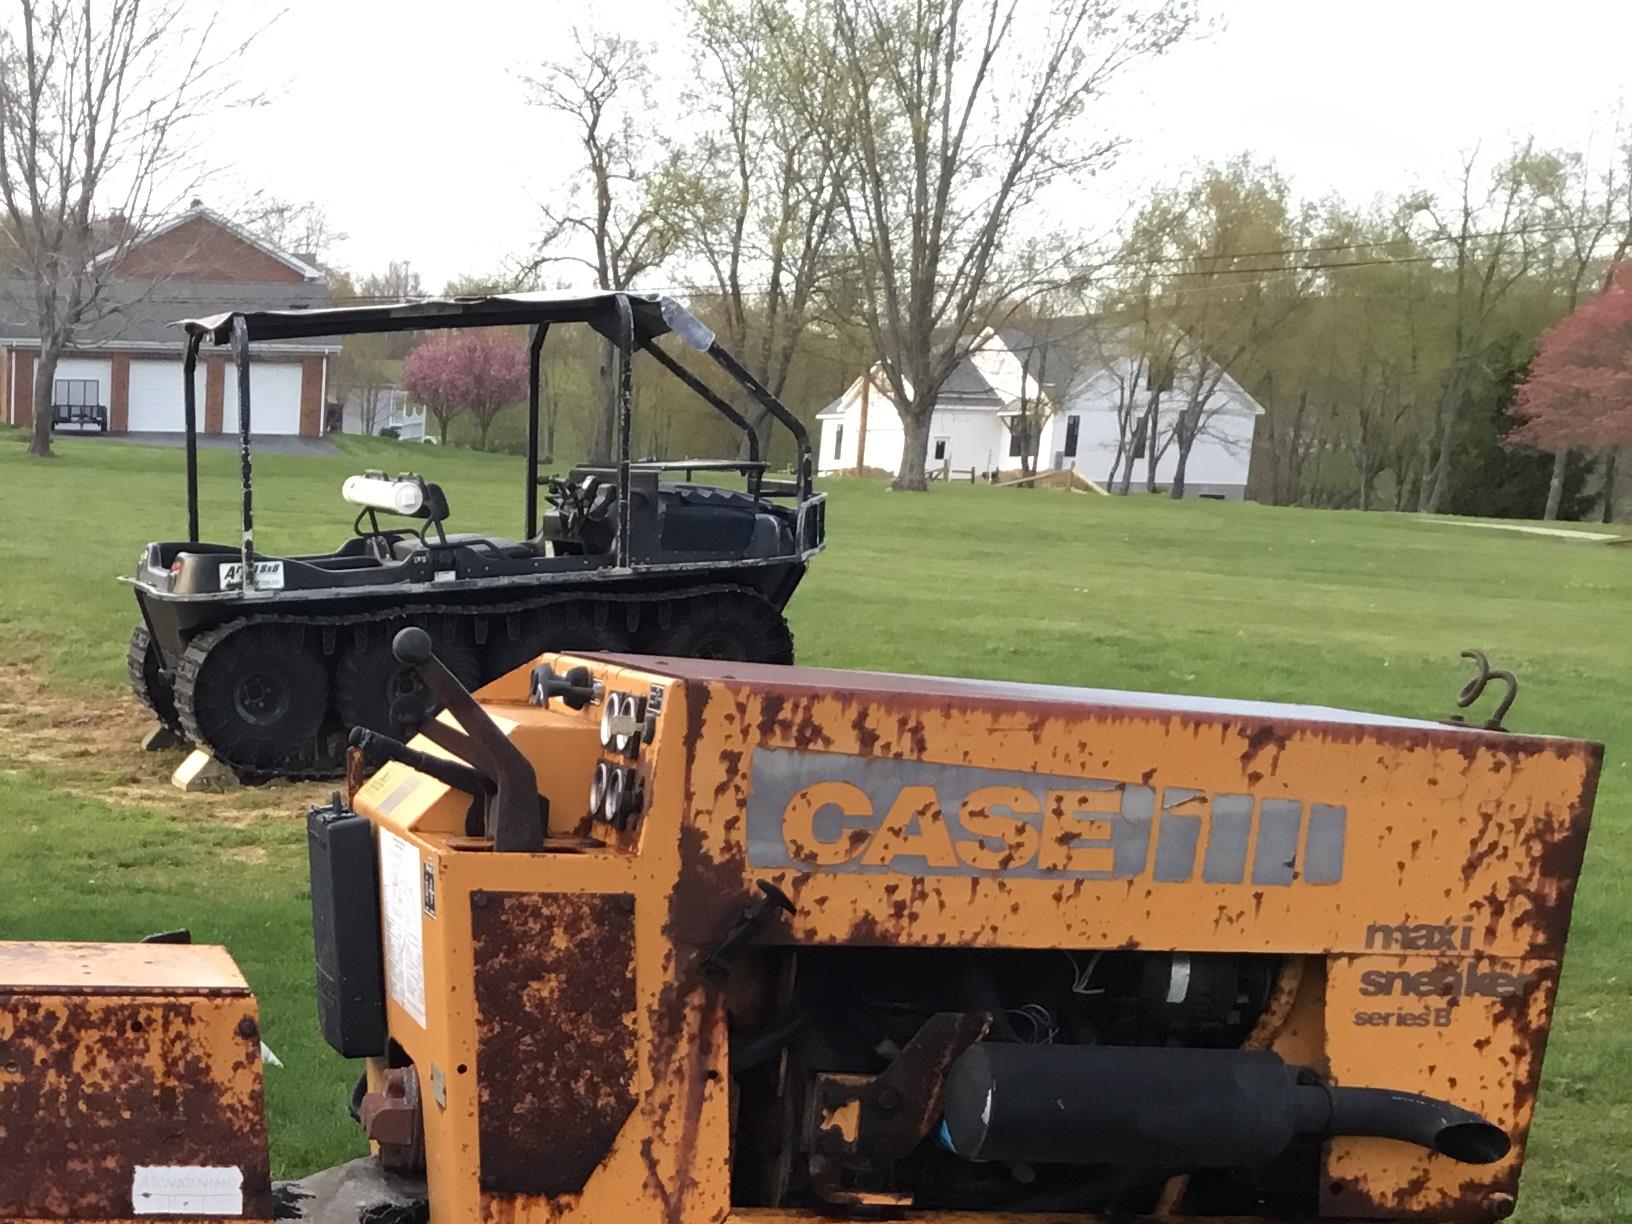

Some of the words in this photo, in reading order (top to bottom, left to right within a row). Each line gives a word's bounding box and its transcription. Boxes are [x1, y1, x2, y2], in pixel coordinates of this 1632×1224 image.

[782, 781, 1119, 871] CASE
[1365, 915, 1474, 950] maxi
[1354, 1008, 1430, 1027] series
[1434, 1008, 1451, 1027] B
